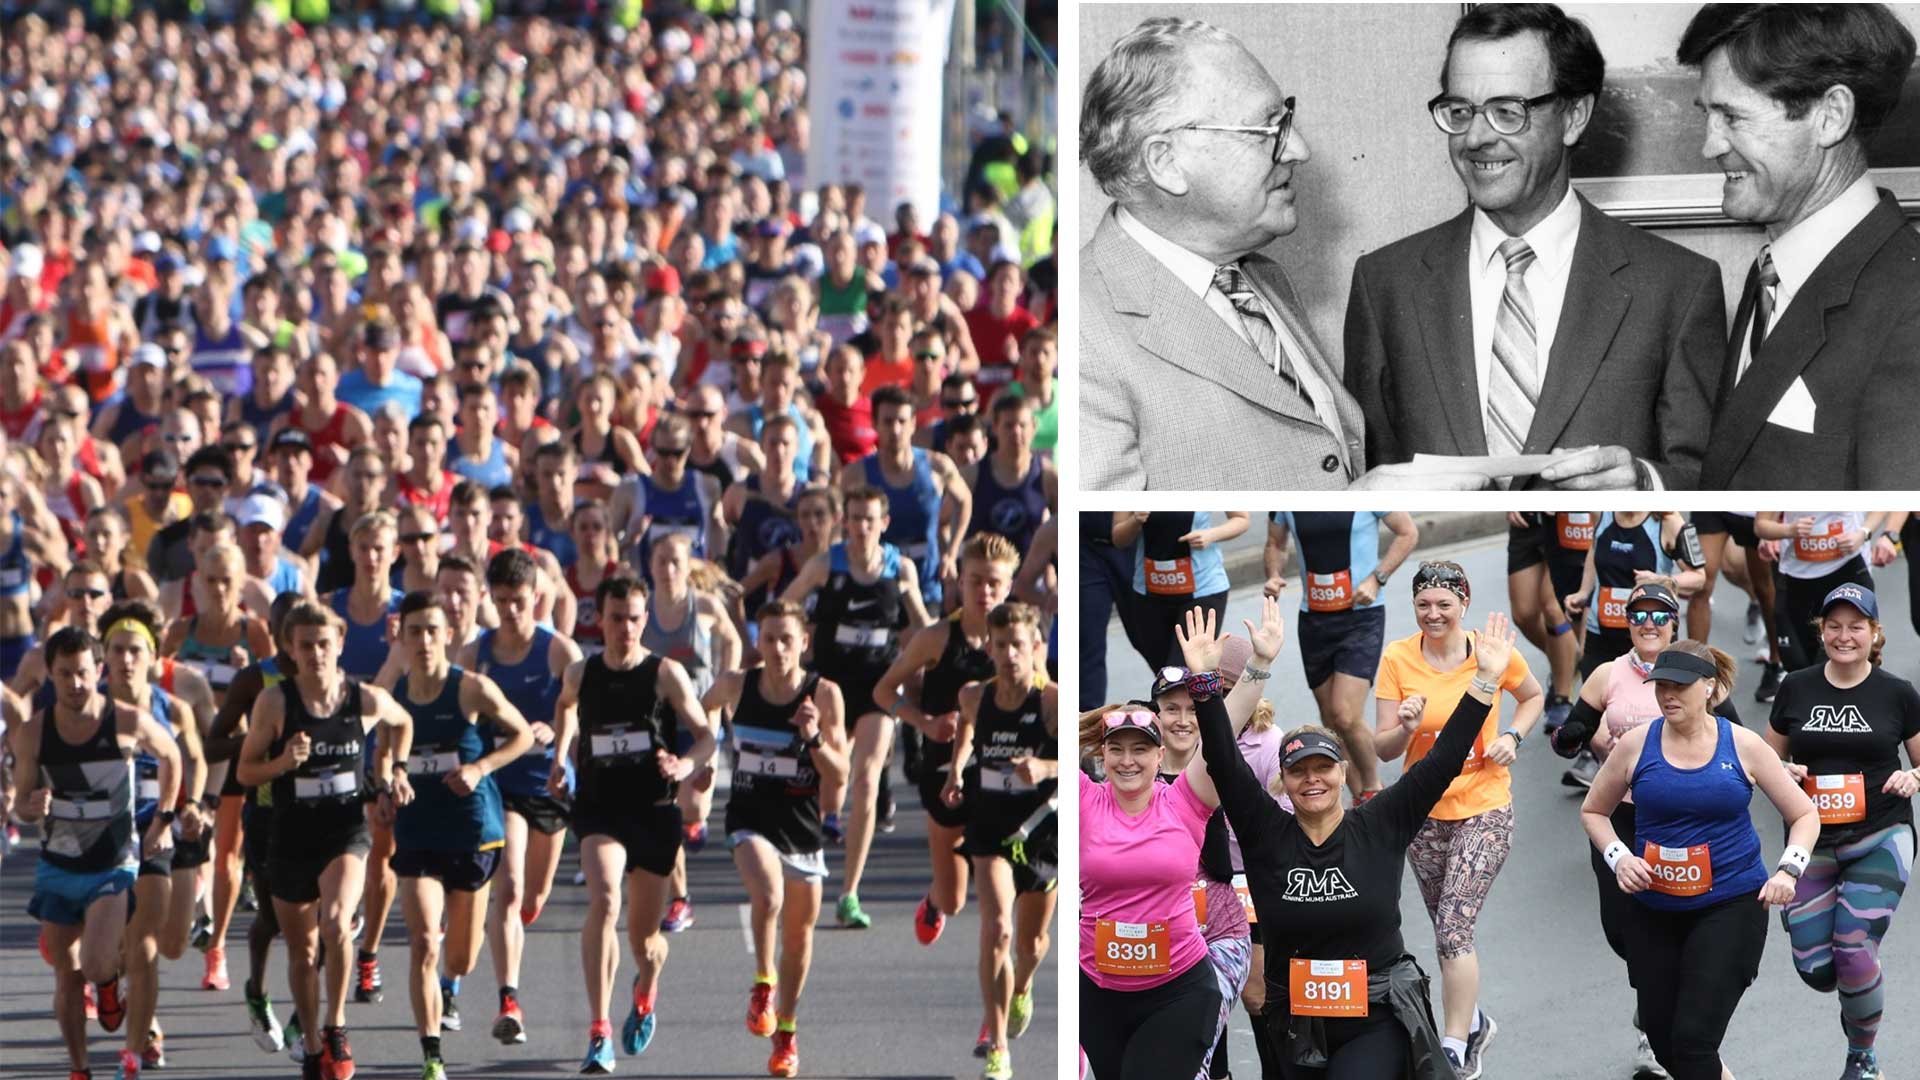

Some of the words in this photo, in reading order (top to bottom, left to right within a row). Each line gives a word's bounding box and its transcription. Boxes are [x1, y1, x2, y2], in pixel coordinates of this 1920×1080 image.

[1799, 538, 1838, 551] 6566
[1150, 572, 1187, 585] 8395
[1310, 586, 1346, 601] 8394
[1603, 602, 1632, 617] 839
[992, 731, 1018, 743] new
[314, 739, 360, 756] Grath
[612, 739, 630, 754] 12
[983, 744, 1034, 758] balance
[760, 761, 776, 774] 14
[320, 781, 335, 793] 11
[1811, 792, 1856, 810] 4839
[1653, 863, 1701, 882] 4620
[1305, 895, 1324, 903] MUMS
[1325, 891, 1359, 902] AUSTRALIA
[1107, 941, 1157, 961] 8391
[1304, 980, 1351, 1001] 8191
